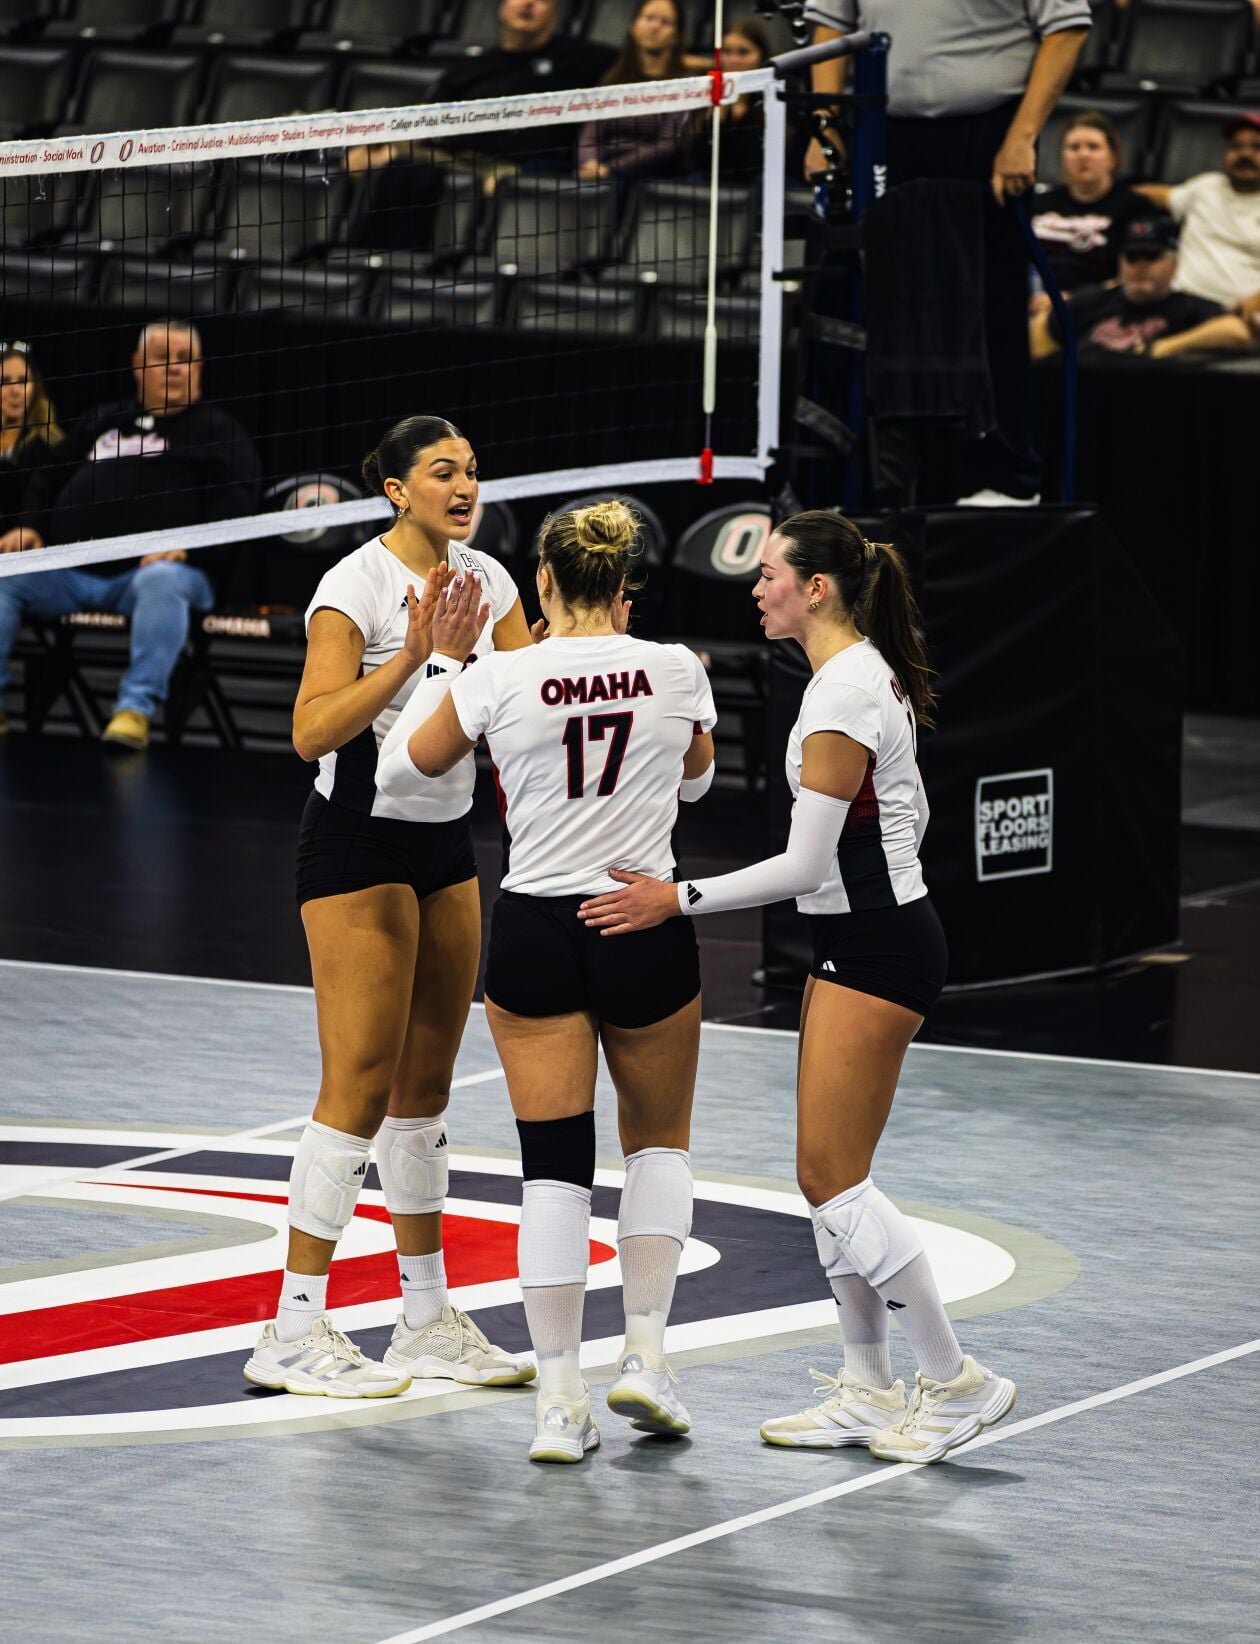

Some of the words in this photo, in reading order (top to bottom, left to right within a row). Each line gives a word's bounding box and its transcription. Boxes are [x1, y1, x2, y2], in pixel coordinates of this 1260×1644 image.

[43, 150, 64, 162] Social
[65, 147, 83, 160] Work
[138, 142, 165, 154] Aviation
[171, 138, 200, 152] Criminal
[200, 136, 223, 149] Justice
[281, 128, 305, 141] Studies
[308, 126, 343, 140] Emergency
[345, 122, 385, 136] Management
[391, 118, 412, 131] College
[440, 112, 460, 125] Affairs
[468, 109, 499, 122] Community
[540, 668, 654, 706] OMAHA
[561, 710, 634, 800] 17
[980, 793, 1049, 823] SPORT
[980, 815, 1050, 840] FLOORS
[980, 832, 1050, 857] LEASING
